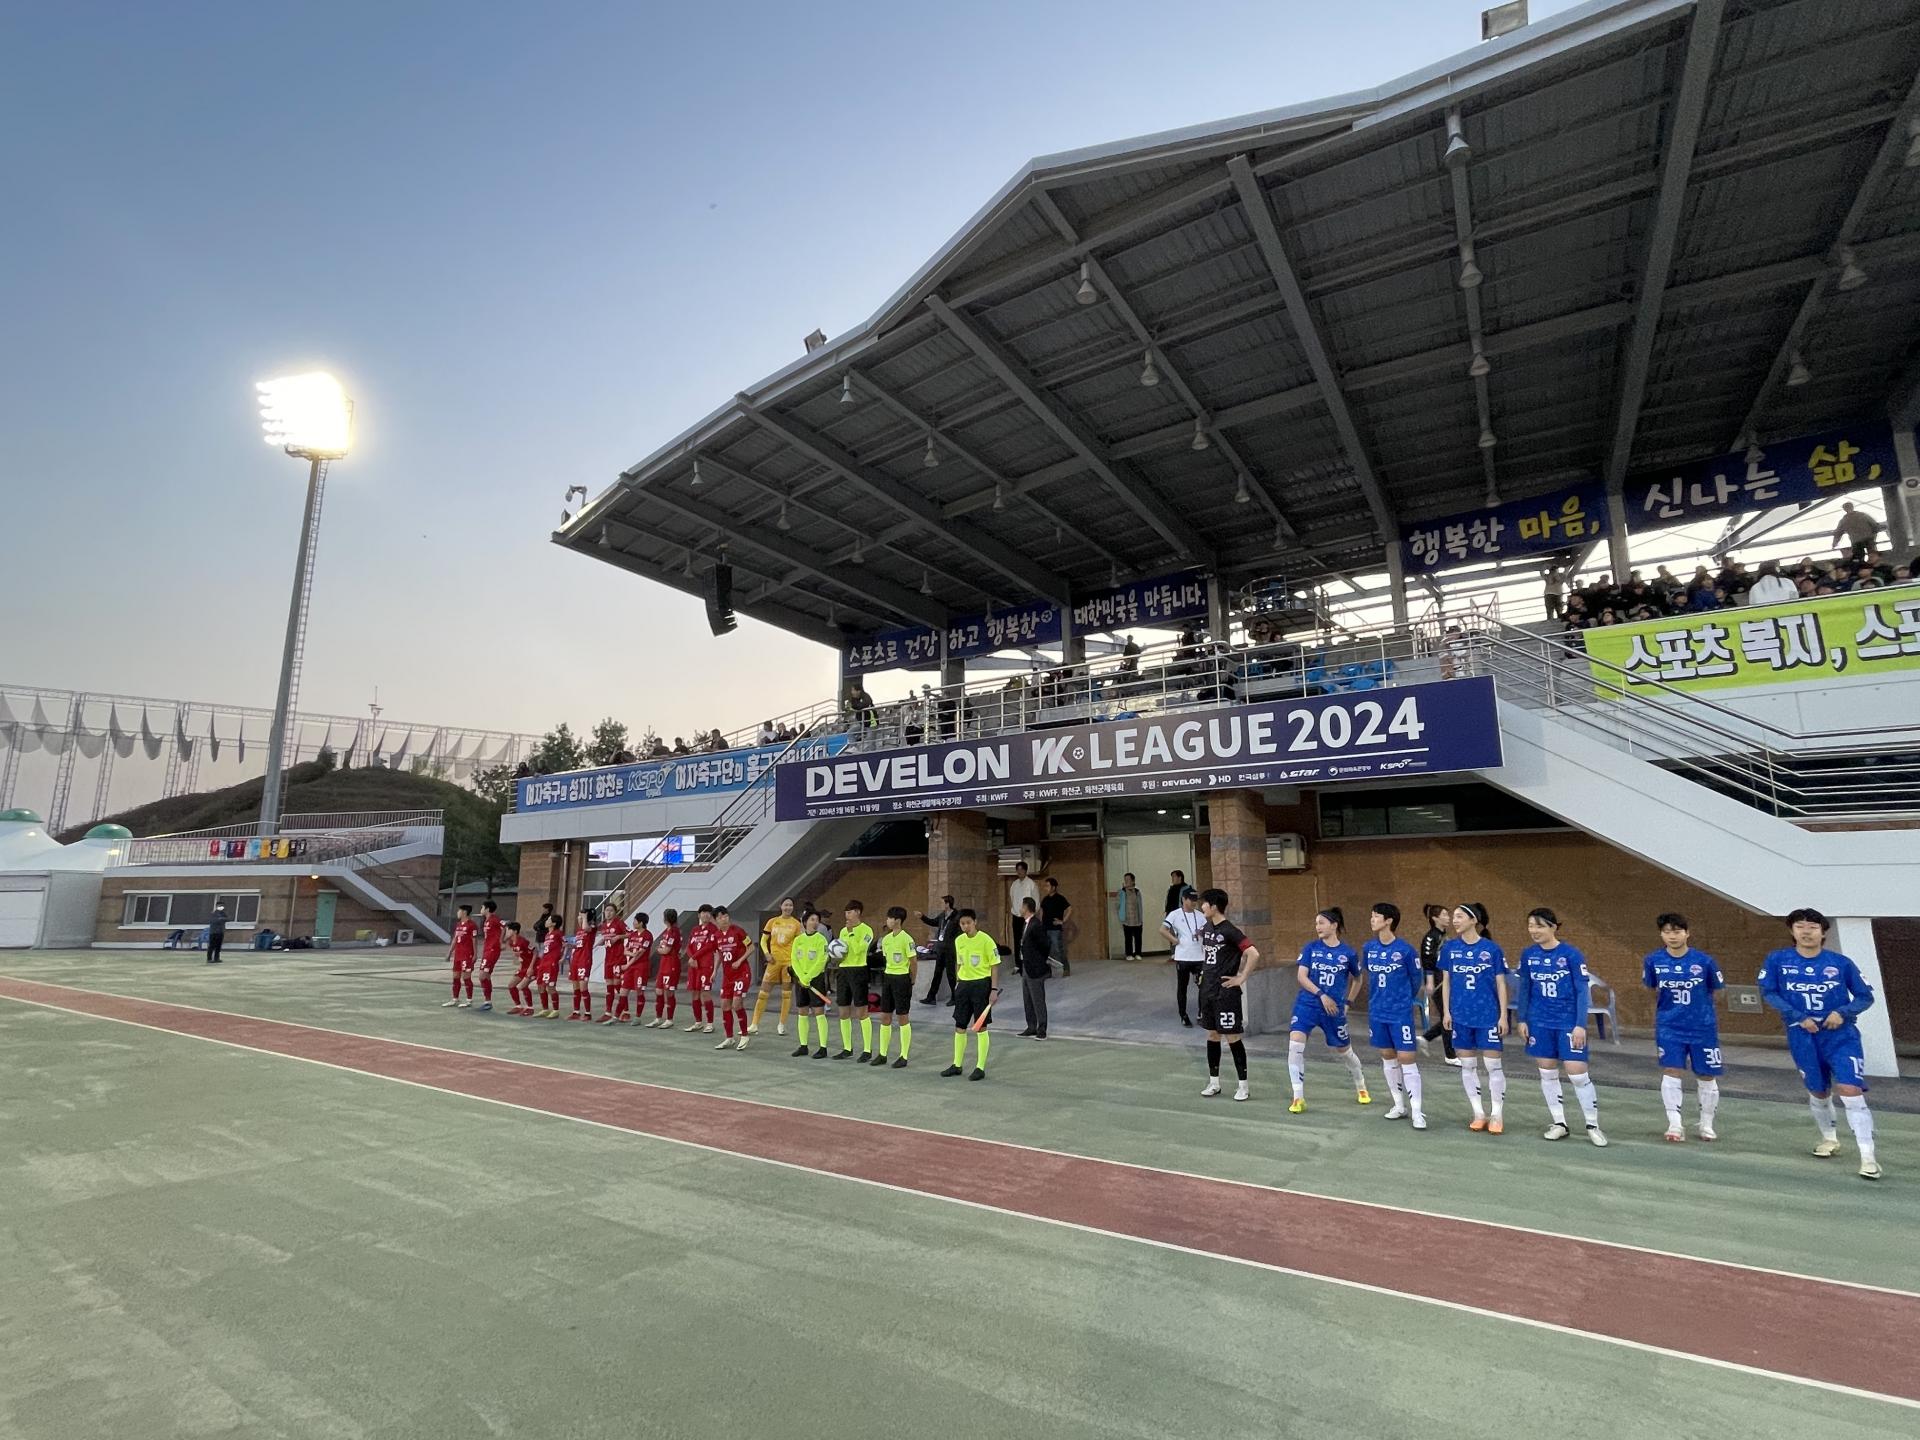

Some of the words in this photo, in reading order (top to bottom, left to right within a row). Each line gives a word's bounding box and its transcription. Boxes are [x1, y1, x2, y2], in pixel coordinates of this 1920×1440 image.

[1643, 462, 1781, 520] 신나는
[1807, 439, 1882, 488] 삶,
[1408, 516, 1505, 566] 행복한
[1518, 496, 1600, 541] 마음,
[1073, 588, 1139, 628] 대한민국을
[1143, 582, 1206, 618] 만듭니다.
[948, 625, 980, 650] 하고
[986, 610, 1041, 646] 행복한
[849, 640, 898, 669] 스포츠로
[904, 630, 939, 661] 건강
[1625, 622, 1738, 686] 스포츠
[1738, 611, 1848, 672] 복지,
[805, 743, 1010, 798] DEVELON
[1089, 711, 1278, 770] LEAGUE
[1286, 695, 1426, 753] 2024
[1380, 761, 1405, 770] KSPO
[525, 780, 567, 806] 여자축구의
[569, 776, 593, 801] 성지!
[595, 772, 623, 799] 화천은
[628, 766, 670, 792] KSPO
[675, 757, 744, 790] 여자축구단의
[1161, 777, 1202, 787] DEVELON
[1218, 775, 1232, 783] HD
[990, 792, 1009, 801] KWFF
[1206, 952, 1217, 965] 23
[1311, 961, 1338, 974] KSPO
[1368, 963, 1392, 974] KSPO
[1452, 964, 1482, 974] KSPO
[1319, 972, 1335, 987] 20
[1378, 973, 1387, 988] 8
[1465, 974, 1476, 990] 2
[1530, 971, 1560, 981] KSPO
[1540, 982, 1557, 998] 18
[1659, 980, 1694, 989] KSPO
[1786, 982, 1828, 993] KSPO
[1671, 989, 1691, 1006] 30
[1802, 992, 1824, 1011] 15
[1220, 1011, 1235, 1026] 23
[1402, 1025, 1412, 1041] 8
[1703, 1047, 1722, 1065] 30
